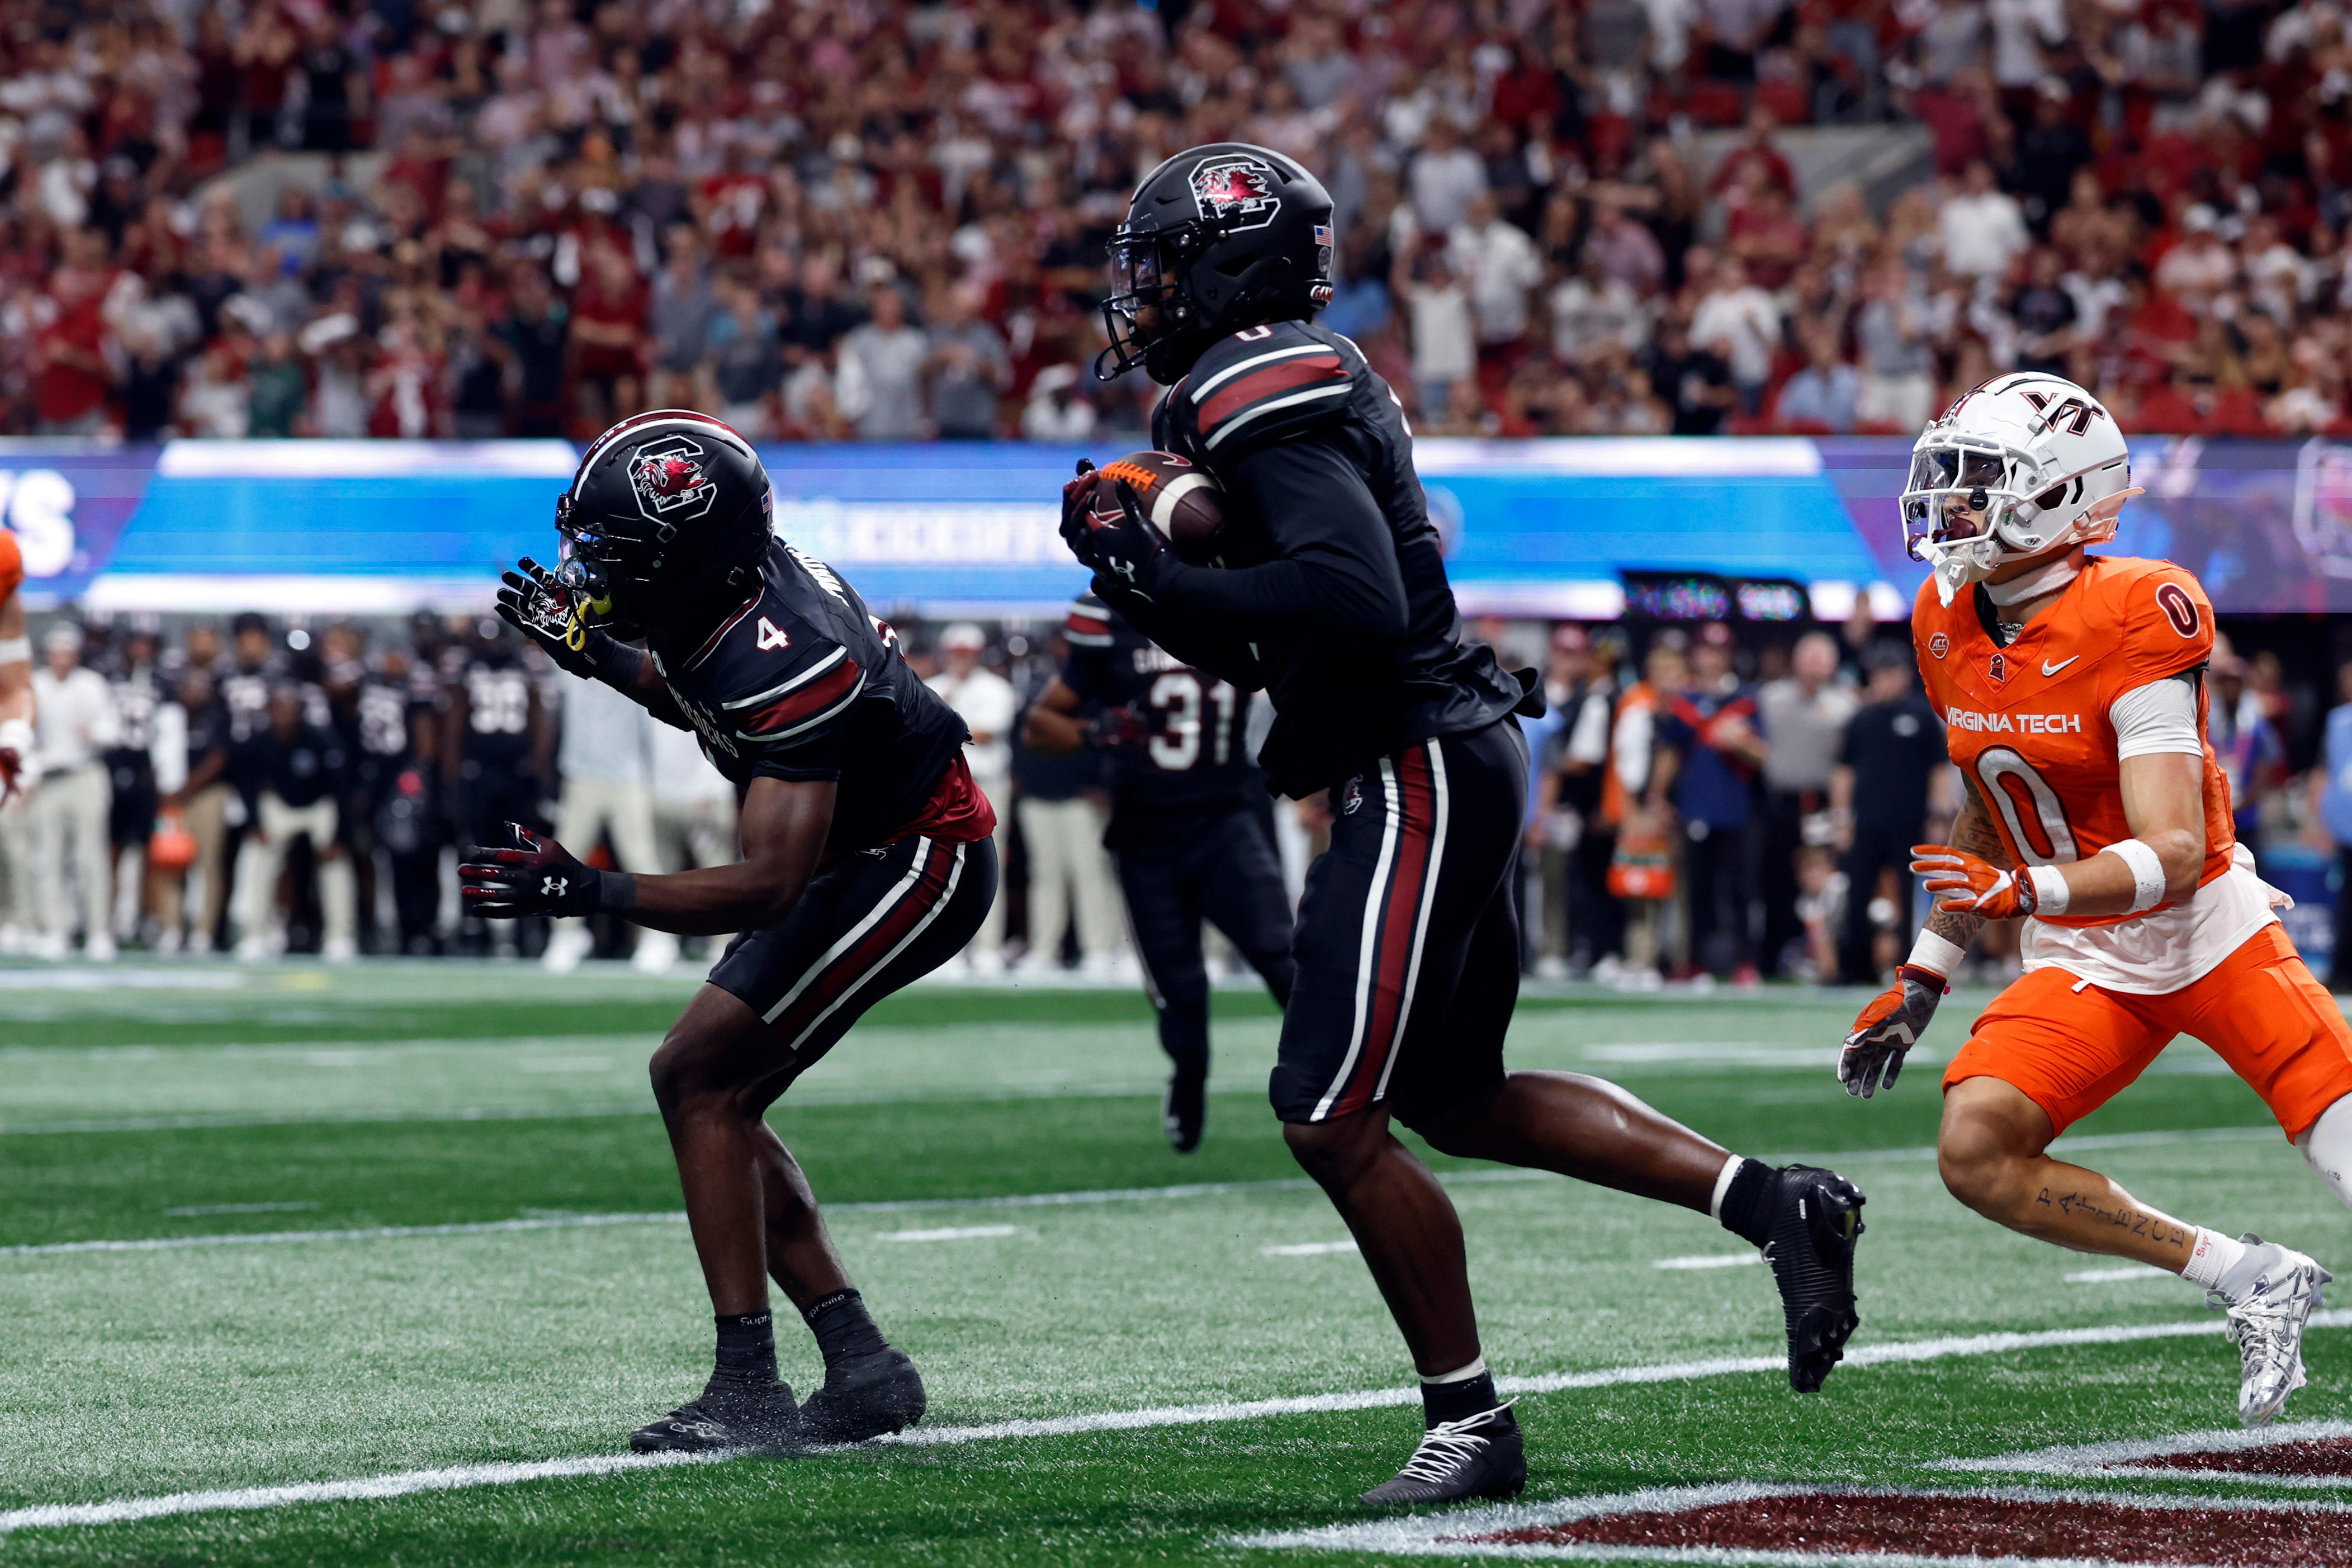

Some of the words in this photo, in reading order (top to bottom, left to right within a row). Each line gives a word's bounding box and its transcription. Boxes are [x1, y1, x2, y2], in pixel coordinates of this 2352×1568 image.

[756, 614, 792, 653] 4
[2155, 582, 2200, 639] 0
[1932, 638, 1947, 648] ACC
[1148, 671, 1237, 771] 31
[1946, 704, 2014, 732] VIRGINIA
[2016, 714, 2081, 733] TECH
[1974, 744, 2081, 870] 0
[2036, 1187, 2185, 1248] PATIENCE
